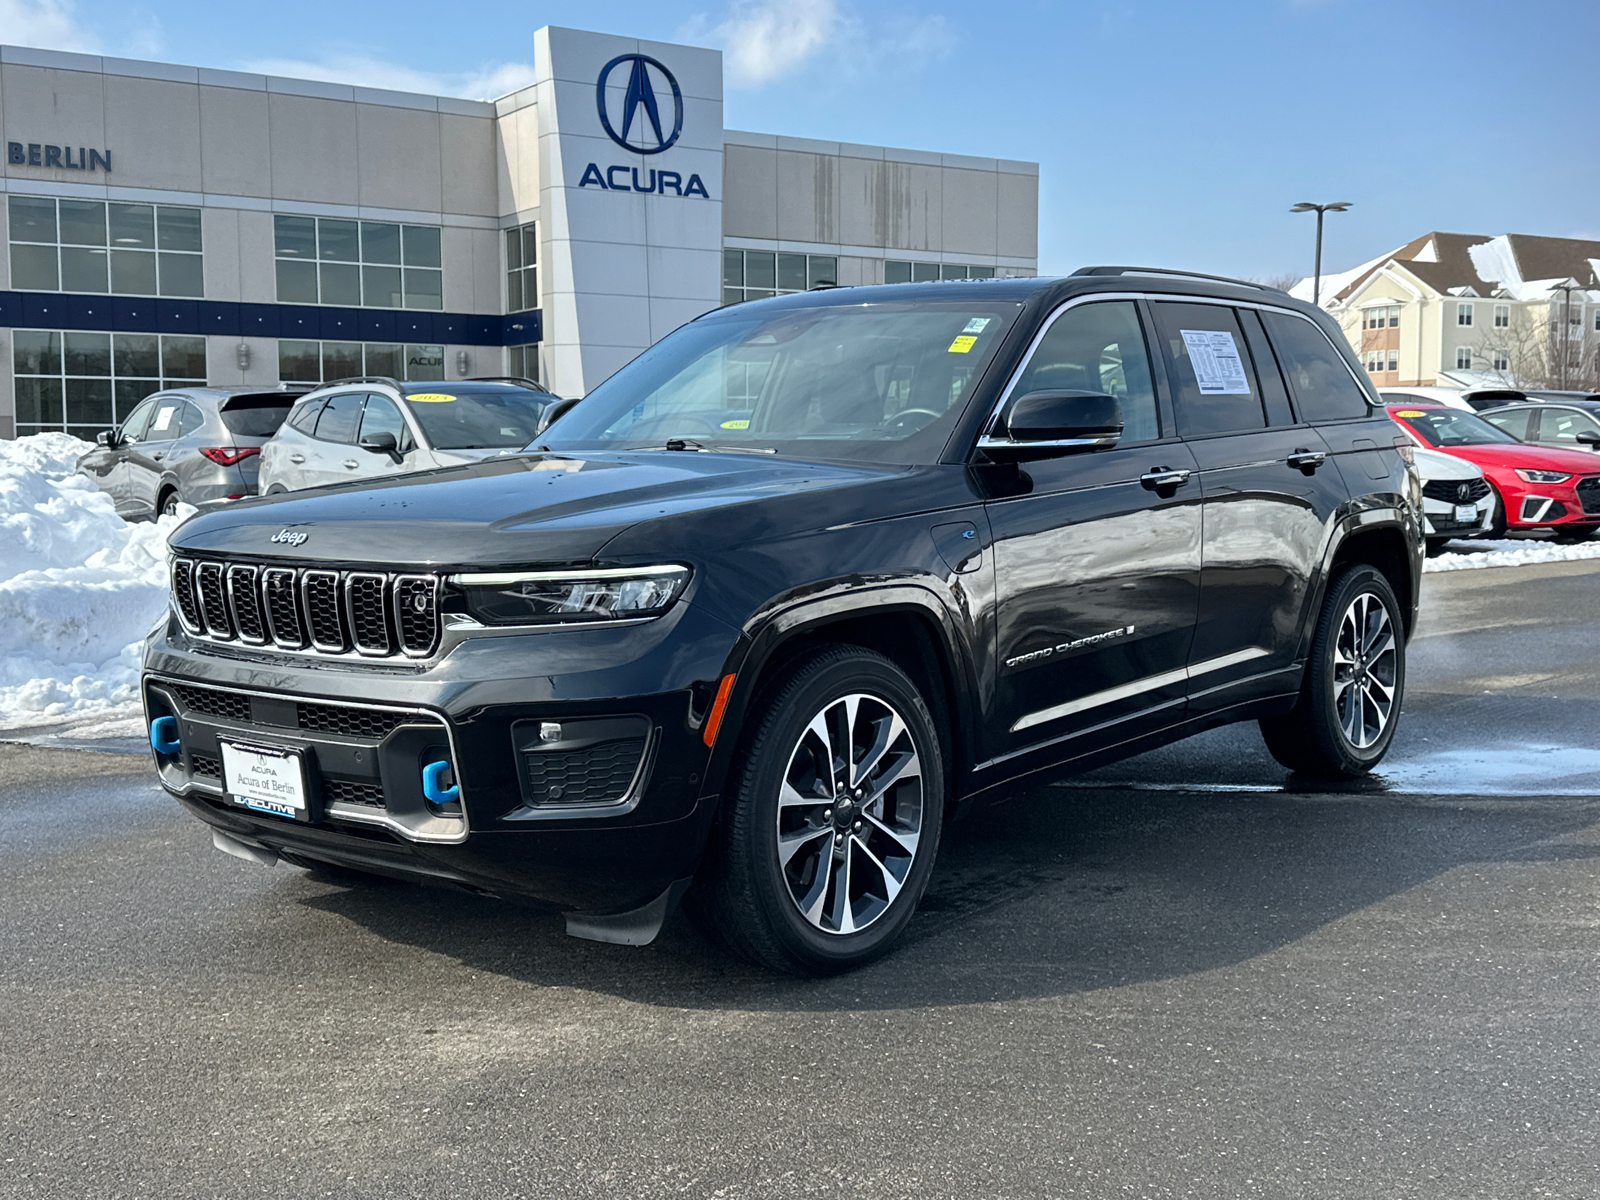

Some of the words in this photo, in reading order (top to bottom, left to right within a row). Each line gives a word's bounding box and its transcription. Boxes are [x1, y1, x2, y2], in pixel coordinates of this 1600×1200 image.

[8, 141, 112, 172] BERLIN
[578, 162, 710, 199] ACURA
[271, 528, 308, 547] Jeep
[1006, 647, 1053, 667] GRAND
[1056, 627, 1124, 653] CHEROKEE
[251, 765, 278, 777] ACURA
[237, 773, 260, 788] Acura
[261, 779, 270, 790] of
[271, 780, 296, 795] Berlin
[233, 794, 295, 815] EXECUTIVE
